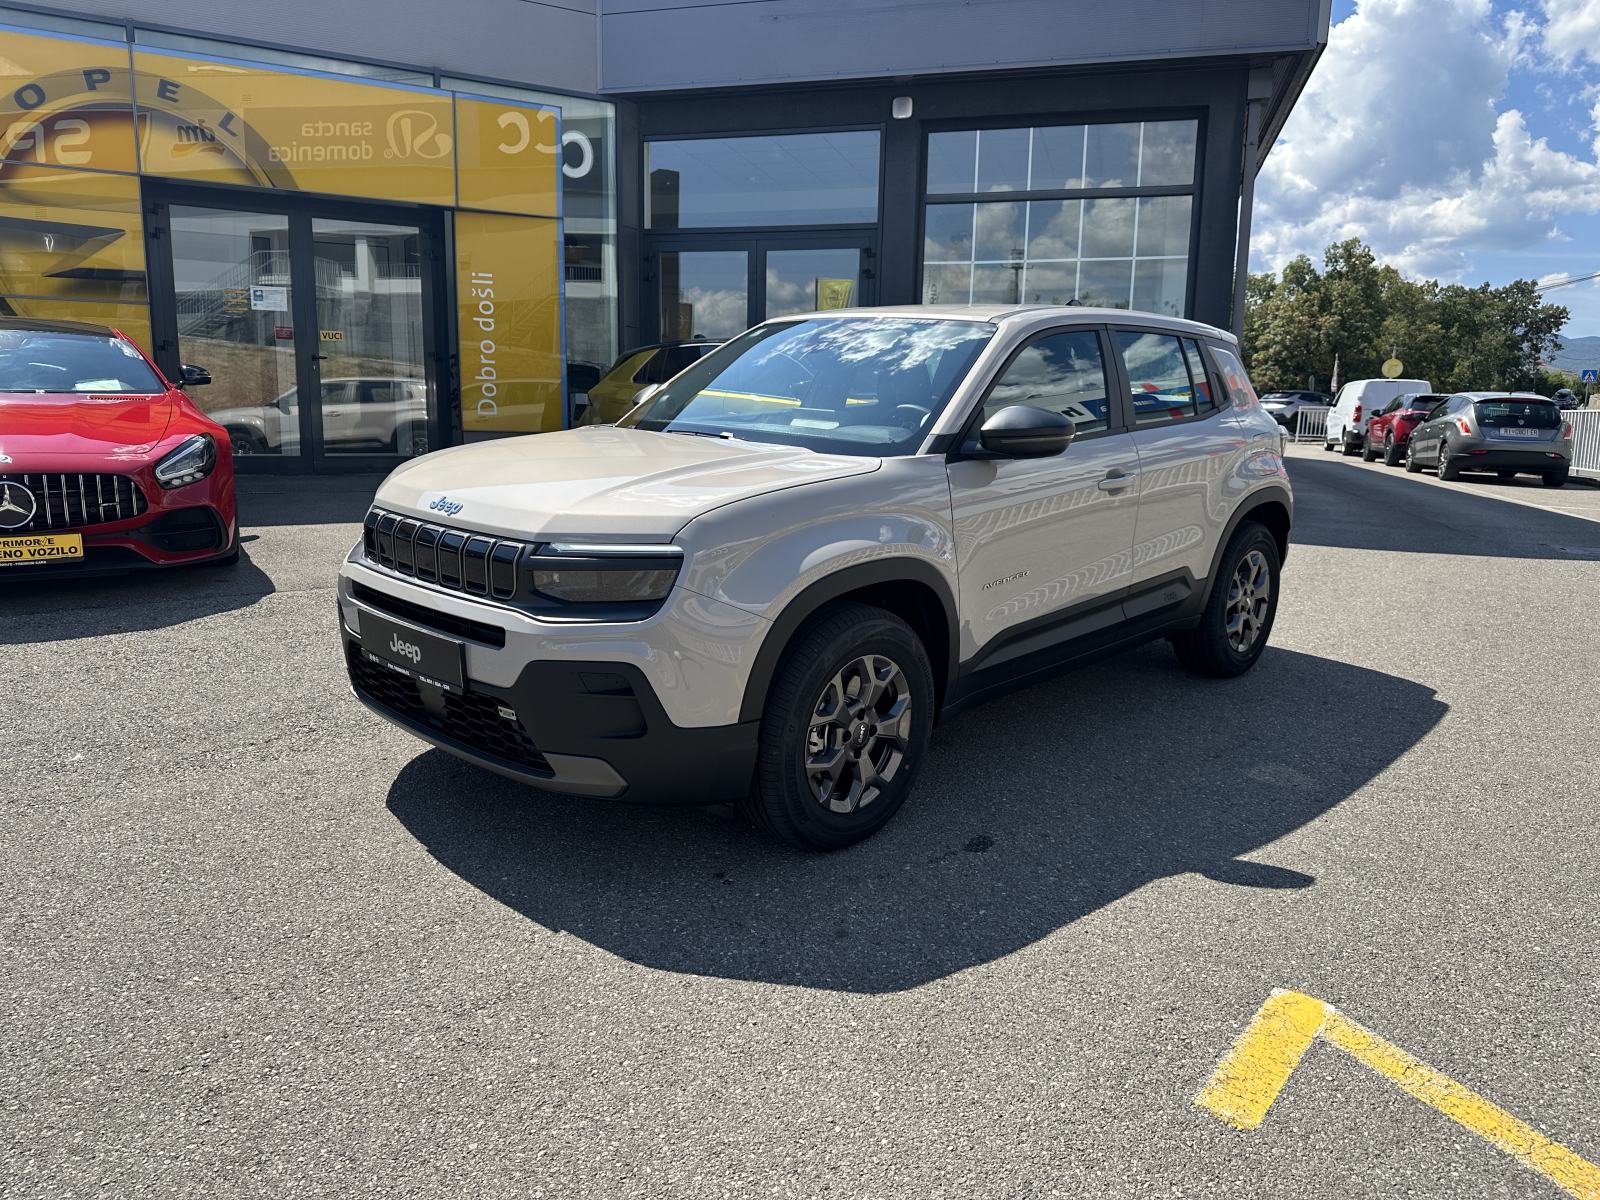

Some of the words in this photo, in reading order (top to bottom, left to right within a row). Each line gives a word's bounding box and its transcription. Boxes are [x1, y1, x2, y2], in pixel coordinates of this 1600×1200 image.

[13, 69, 239, 137] OPEL
[471, 272, 495, 332] došli
[321, 332, 343, 341] VUCI
[475, 339, 498, 417] Dobro
[429, 496, 464, 516] Jeep
[28, 546, 78, 557] VOZILO
[981, 570, 1030, 591] AVENGER
[389, 633, 421, 664] Jeep
